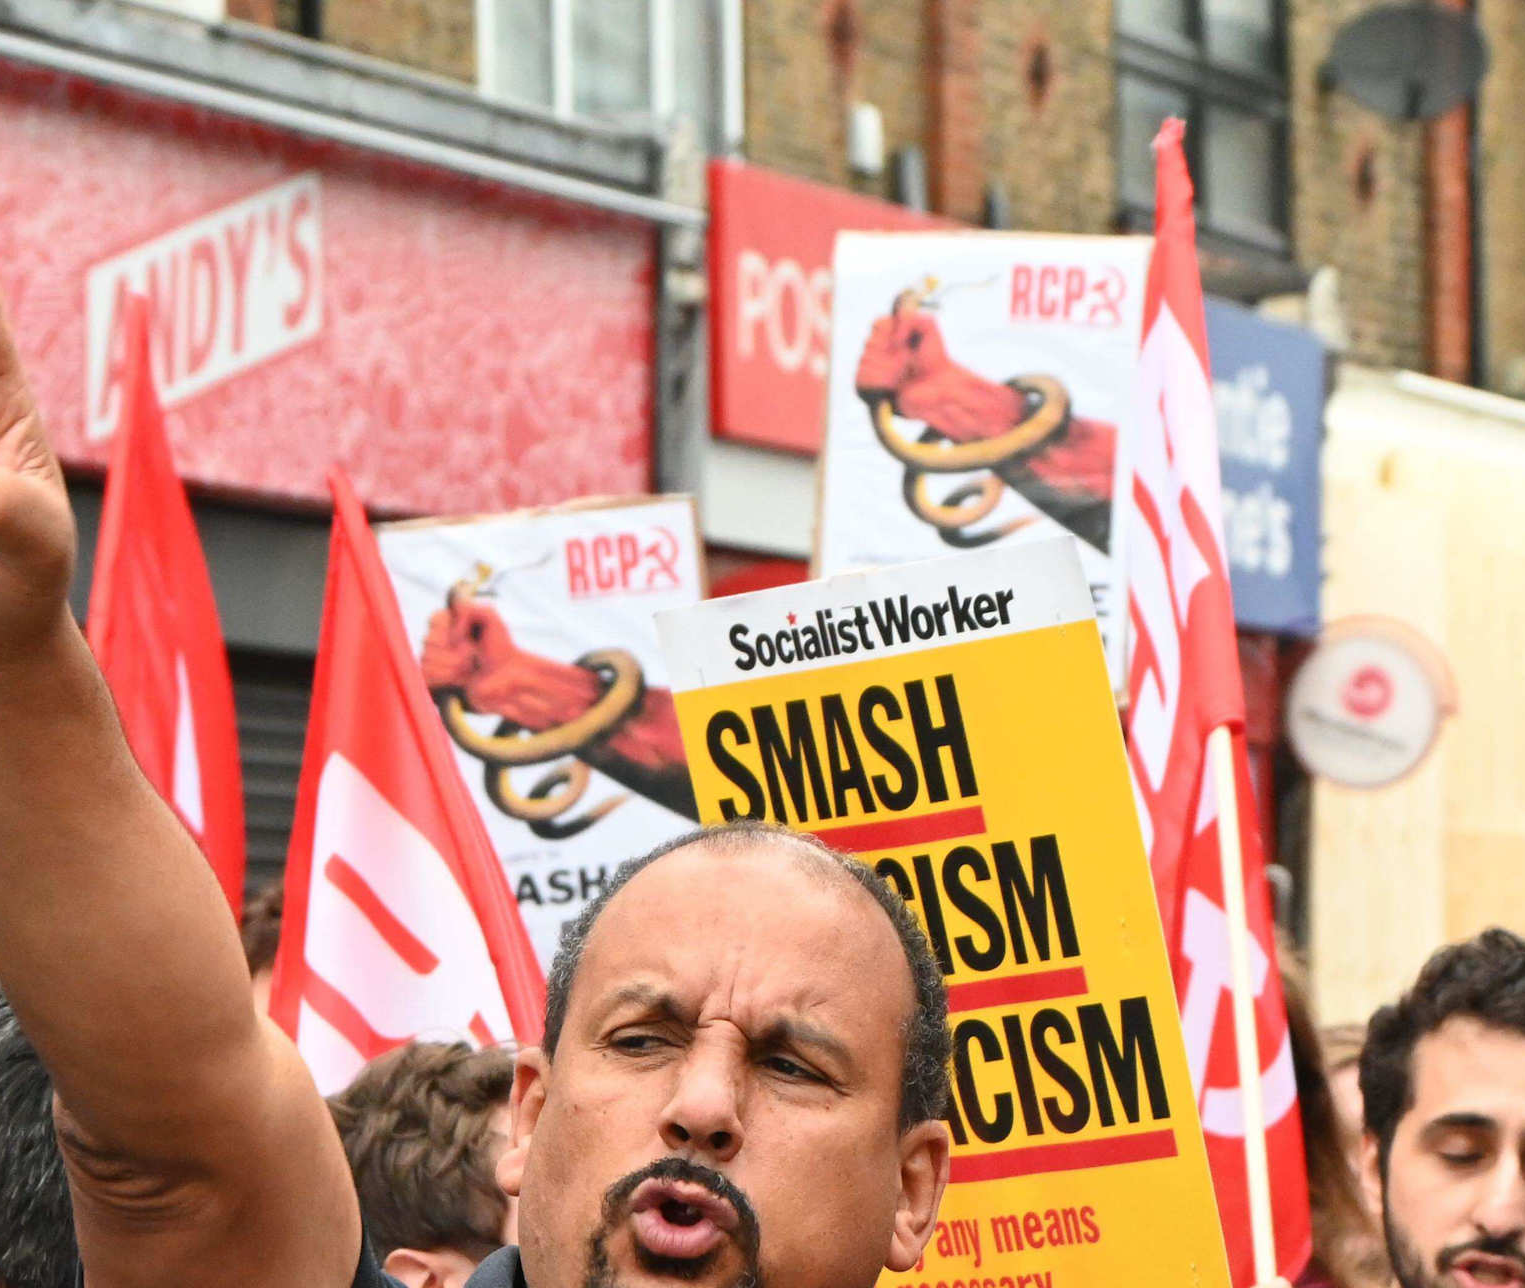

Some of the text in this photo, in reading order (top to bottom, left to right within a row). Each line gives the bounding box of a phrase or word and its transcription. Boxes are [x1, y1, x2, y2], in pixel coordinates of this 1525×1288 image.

[736, 251, 831, 377] POS
[1010, 264, 1087, 321] RCP
[565, 533, 639, 593] RCP
[706, 674, 979, 825] SMASH
[517, 866, 607, 906] ASH
[940, 996, 1171, 1146] CISM
[936, 1216, 982, 1268] any
[991, 1205, 1101, 1253] means
